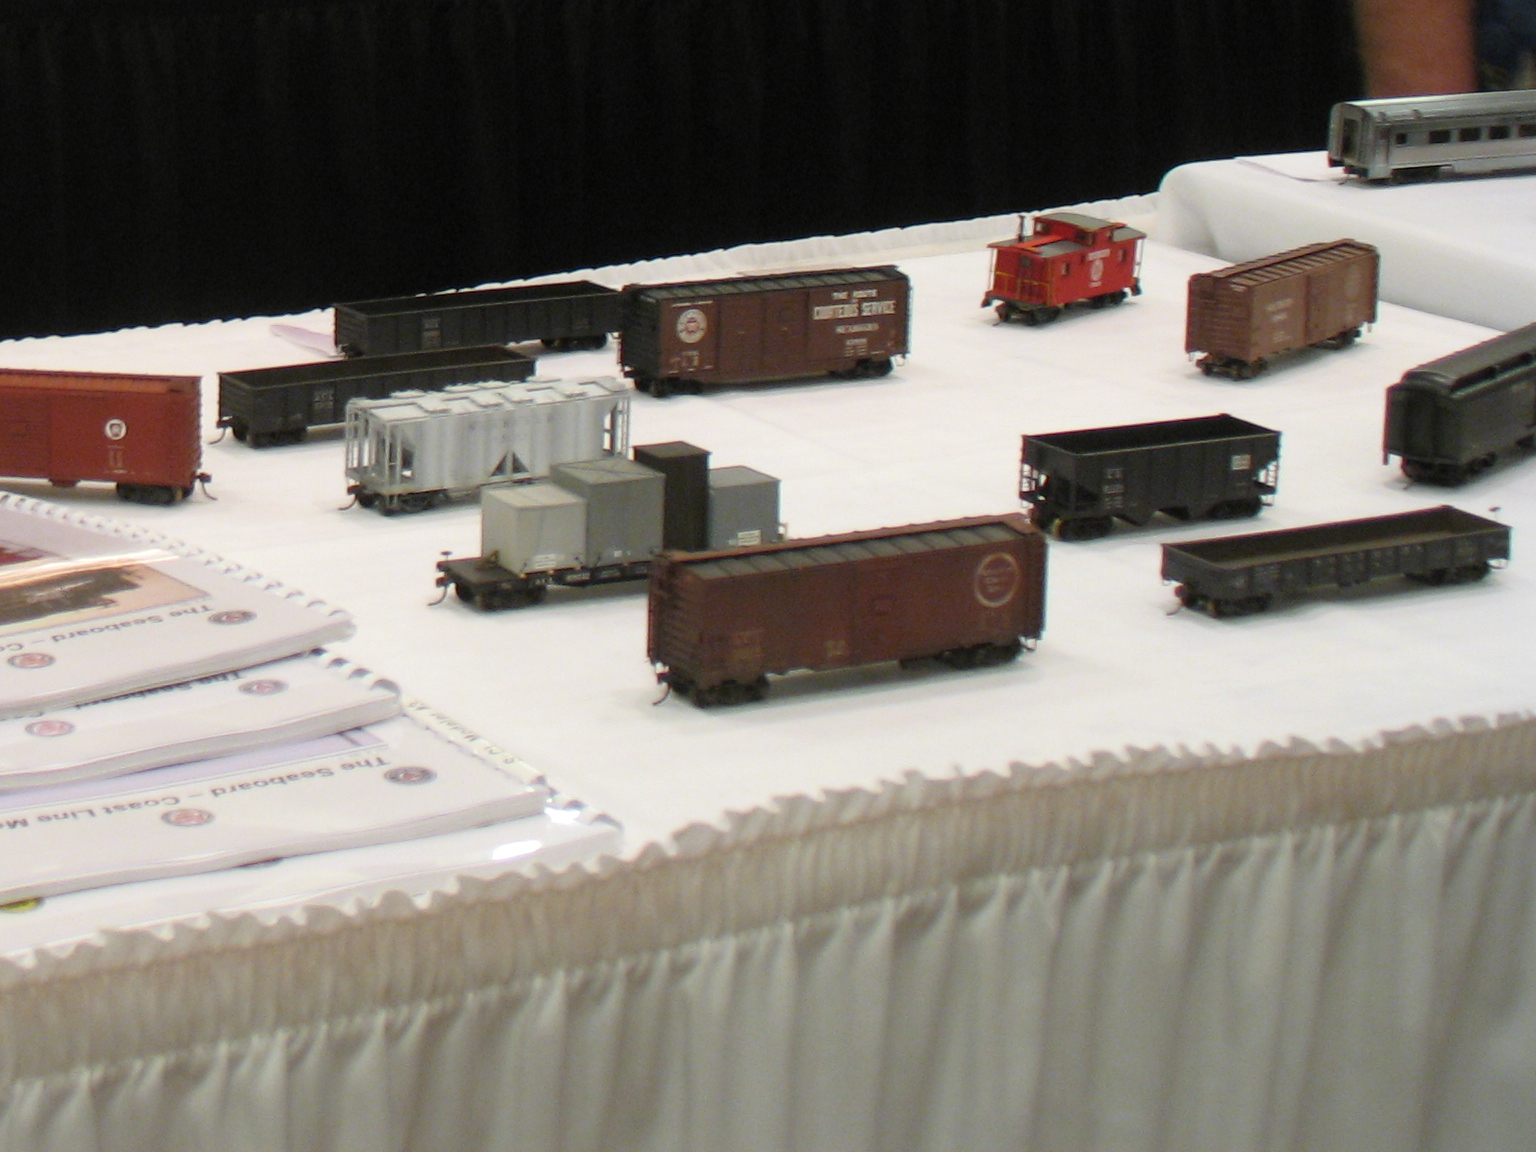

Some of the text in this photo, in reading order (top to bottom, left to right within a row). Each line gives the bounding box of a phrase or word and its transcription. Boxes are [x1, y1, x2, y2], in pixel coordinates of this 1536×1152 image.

[169, 604, 213, 618] The
[51, 614, 164, 643] Seaboard
[340, 756, 390, 772] The
[211, 767, 335, 797] Seaboard
[102, 796, 181, 815] Coast
[36, 807, 97, 824] Line
